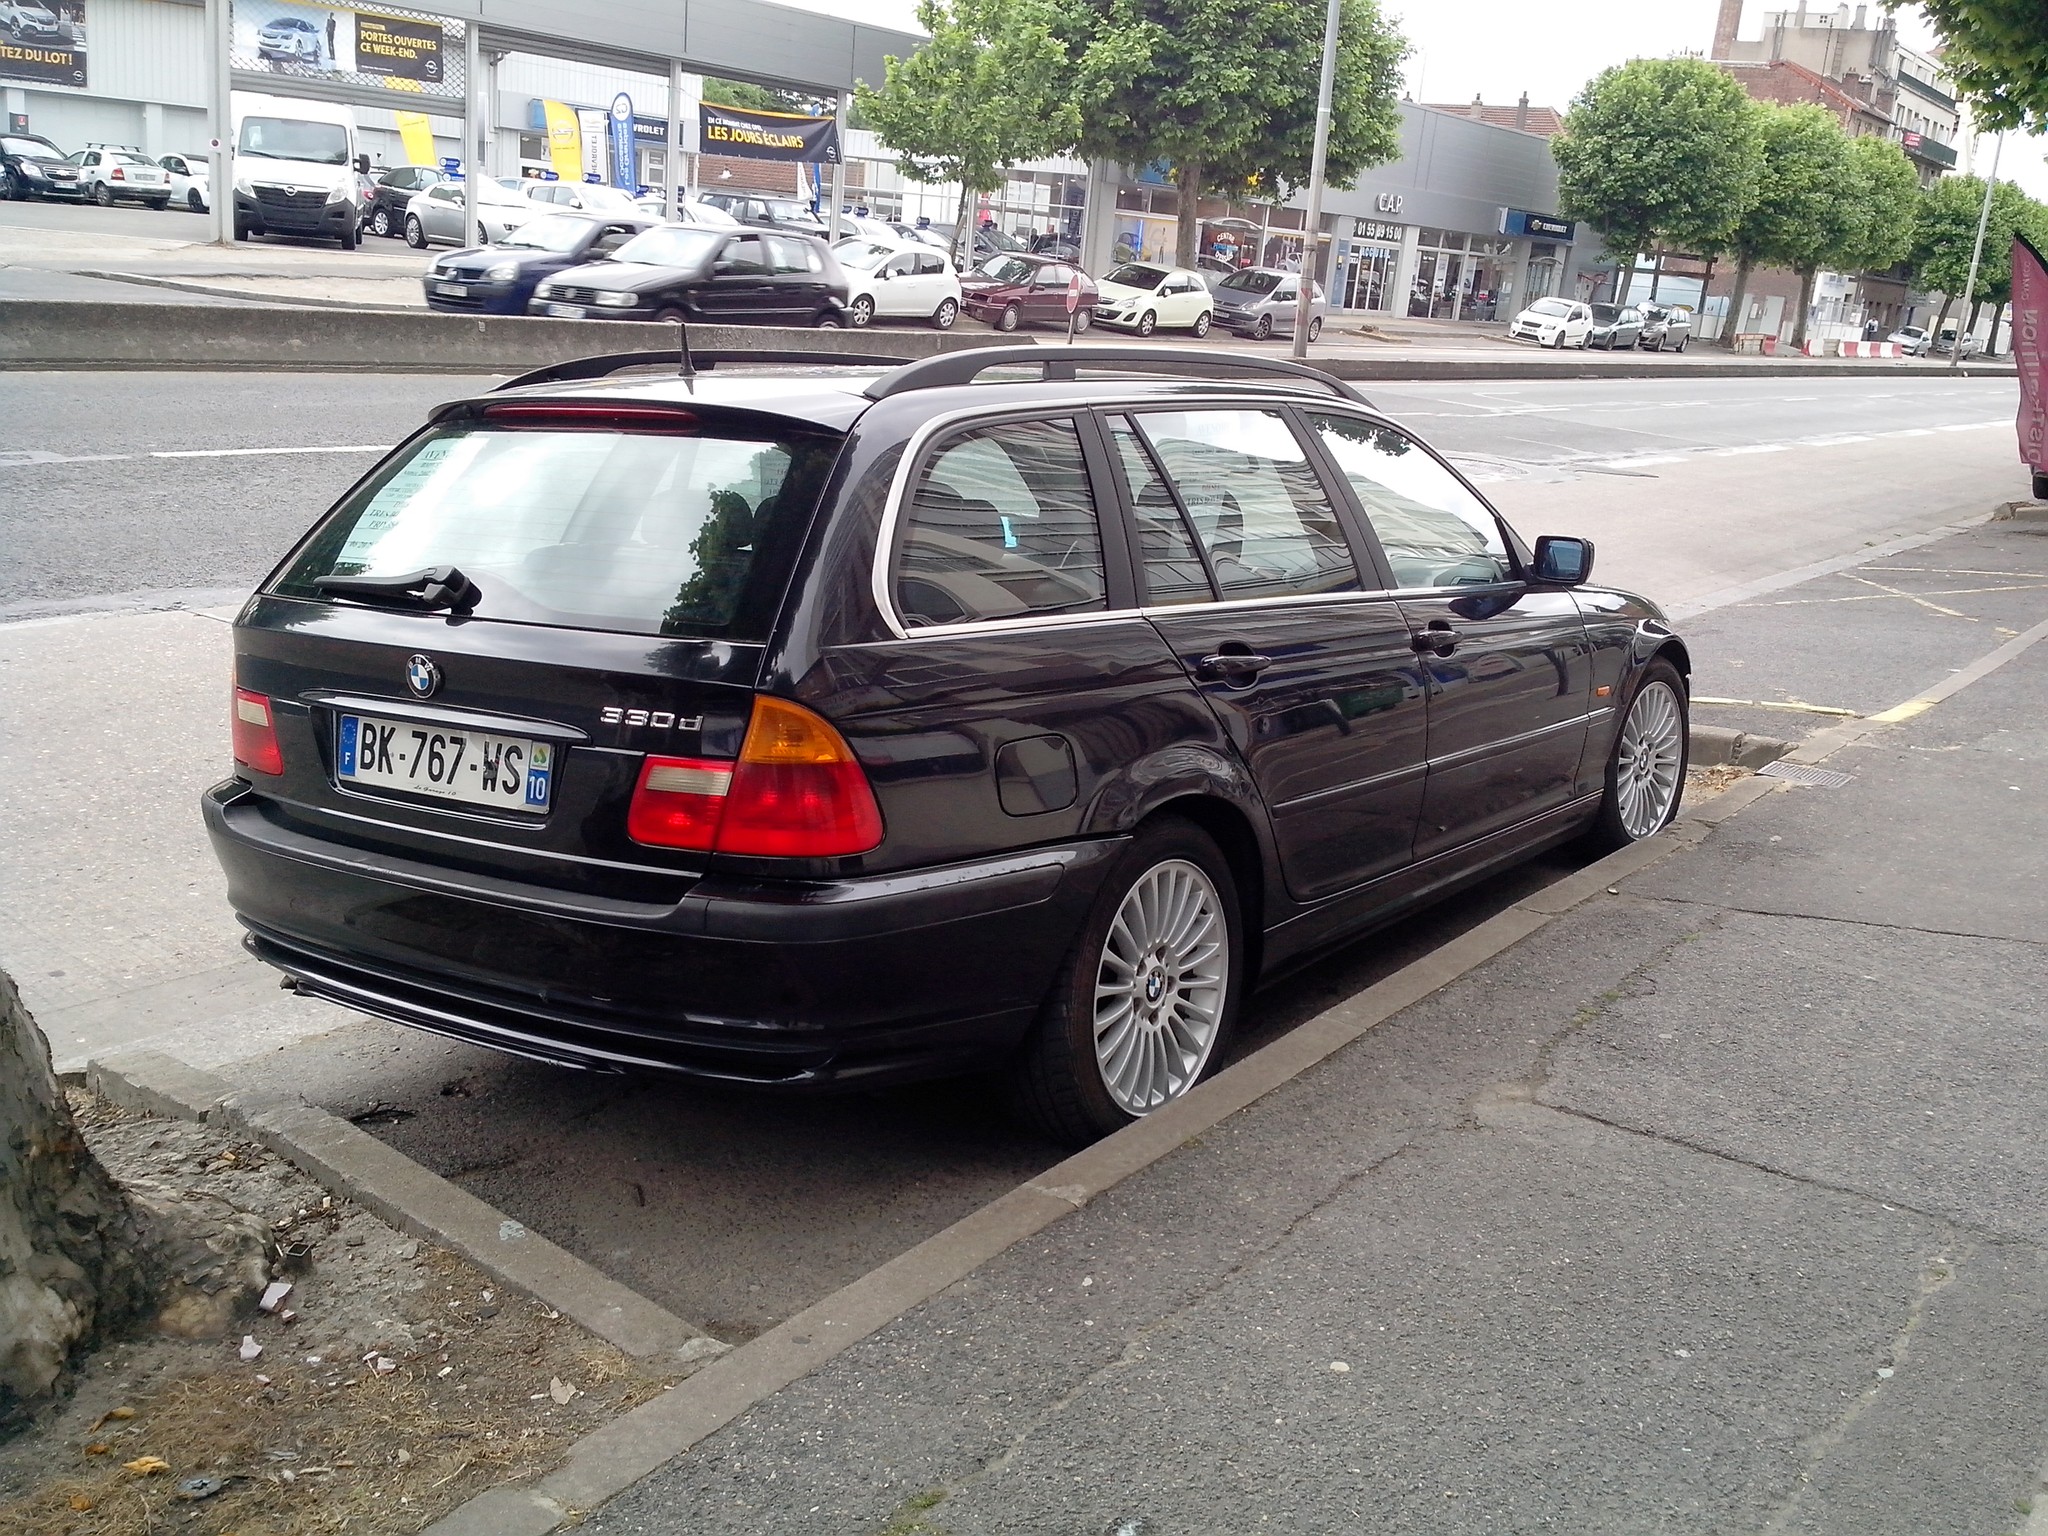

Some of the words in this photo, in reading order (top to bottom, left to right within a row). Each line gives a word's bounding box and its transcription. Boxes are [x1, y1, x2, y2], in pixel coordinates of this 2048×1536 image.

[360, 30, 393, 44] PORTES
[394, 36, 437, 51] OUVERTES
[25, 48, 42, 62] DU
[360, 42, 372, 52] CE
[373, 43, 418, 60] WEEK-END.
[632, 123, 665, 136] VROLET
[708, 126, 728, 141] LES
[730, 129, 762, 145] JOURS
[764, 130, 804, 149] ÉCLAIRS
[600, 706, 704, 732] 330d
[344, 752, 351, 765] F
[530, 775, 546, 800] 10
